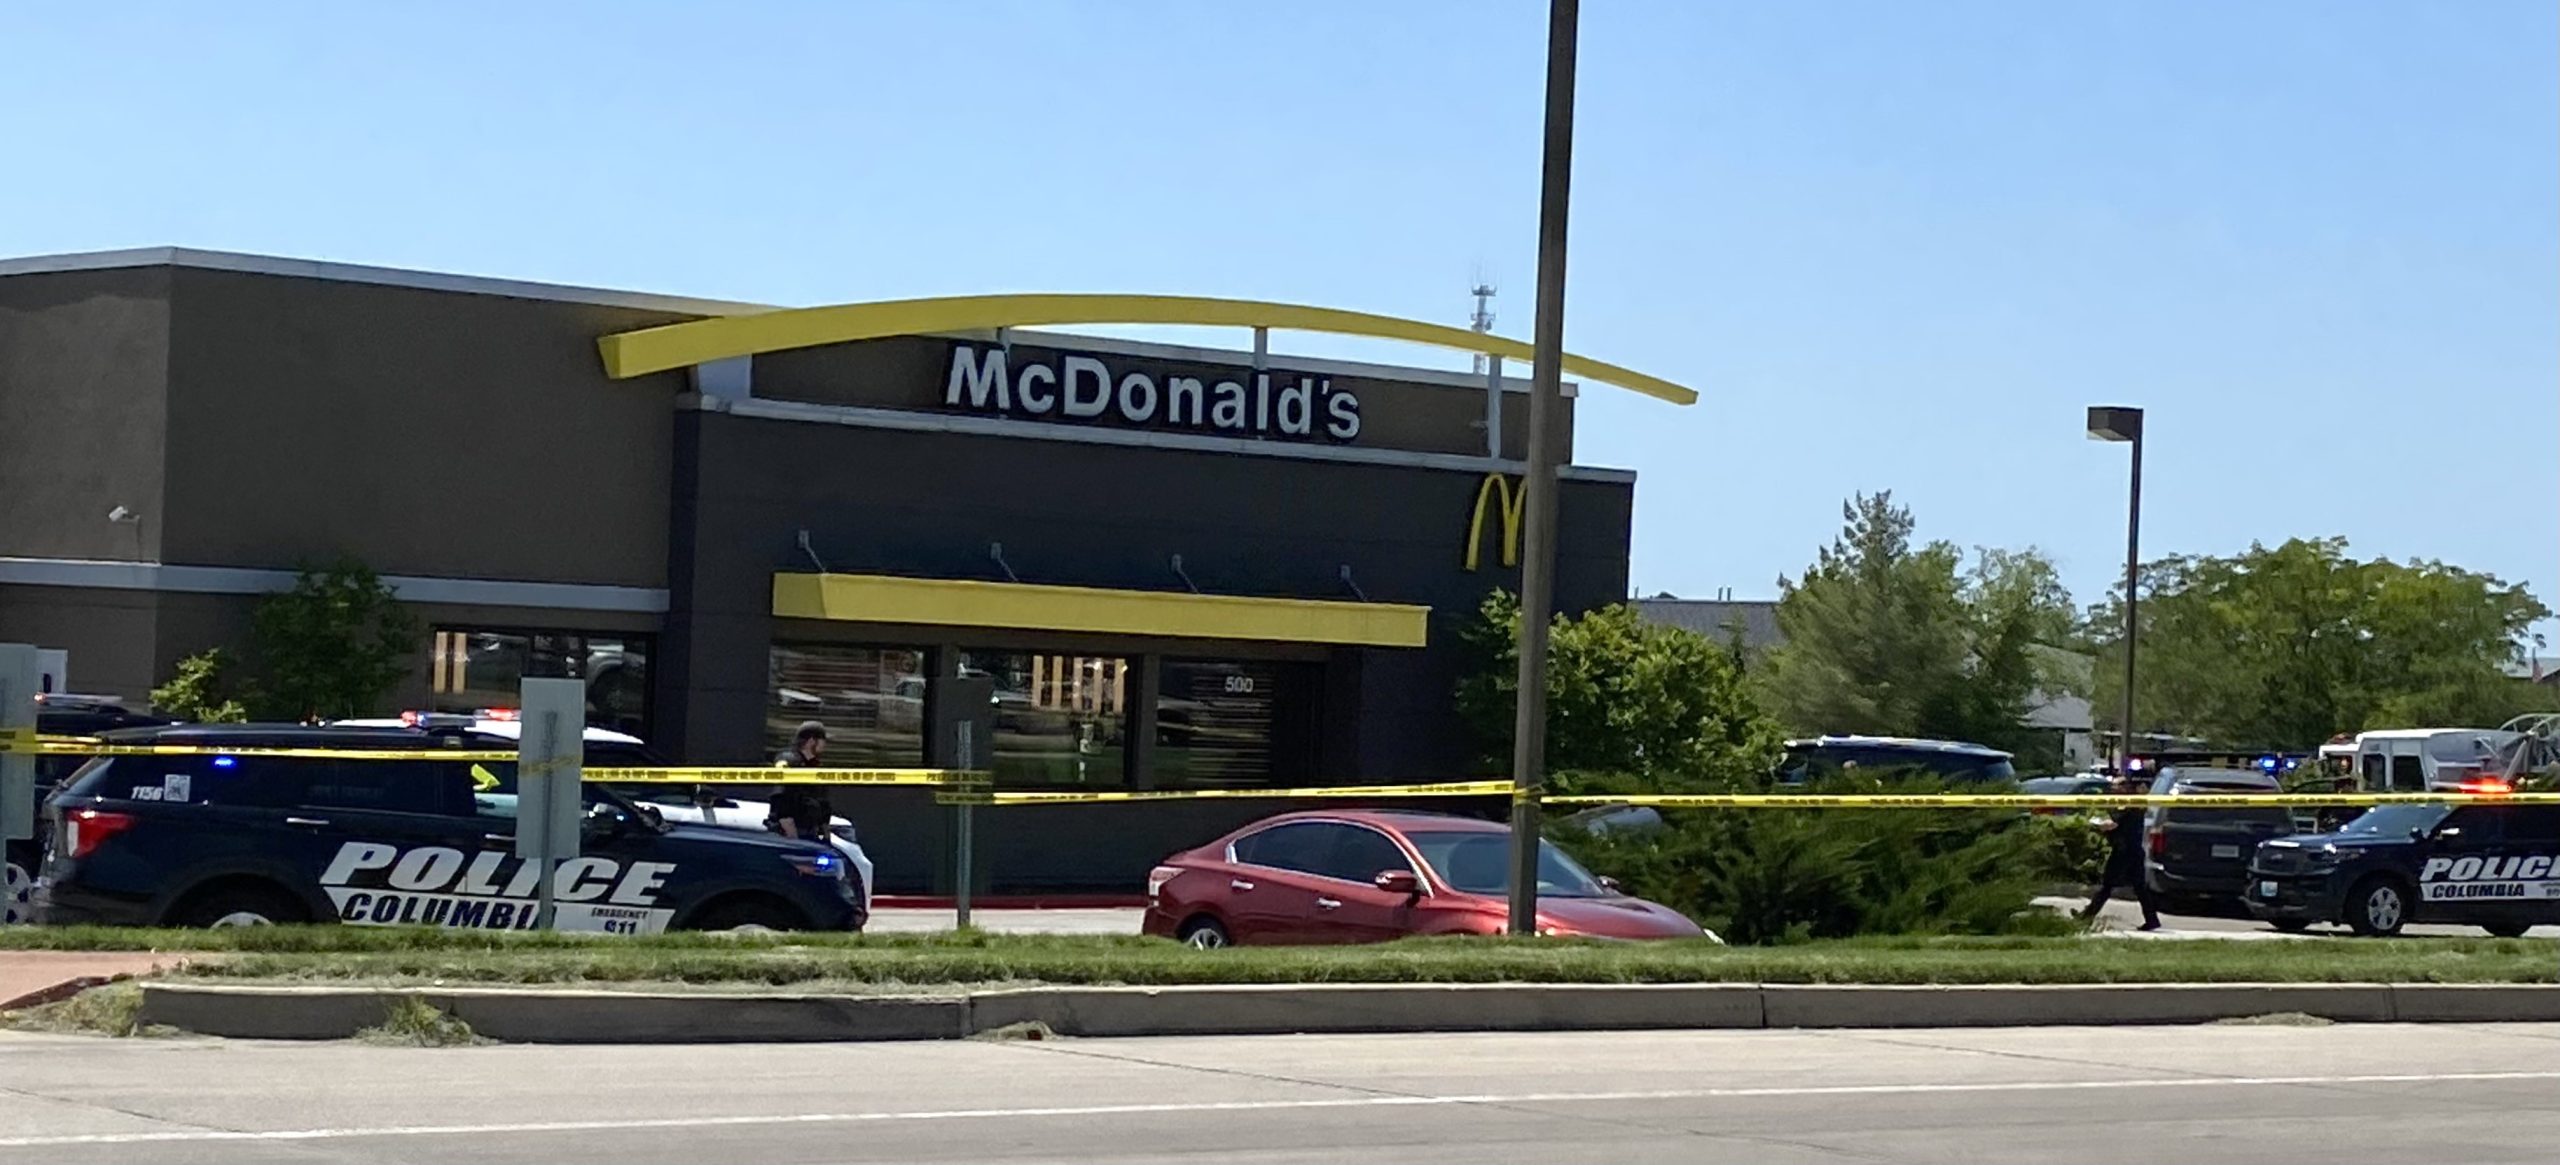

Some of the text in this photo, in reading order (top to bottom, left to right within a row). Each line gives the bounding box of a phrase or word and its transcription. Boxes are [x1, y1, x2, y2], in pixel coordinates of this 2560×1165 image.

[945, 345, 1361, 439] McDonald's
[1225, 676, 1254, 692] 500
[319, 841, 677, 905] POLICE
[2432, 883, 2525, 898] COLUMBIA
[340, 893, 558, 931] COLUMBI
